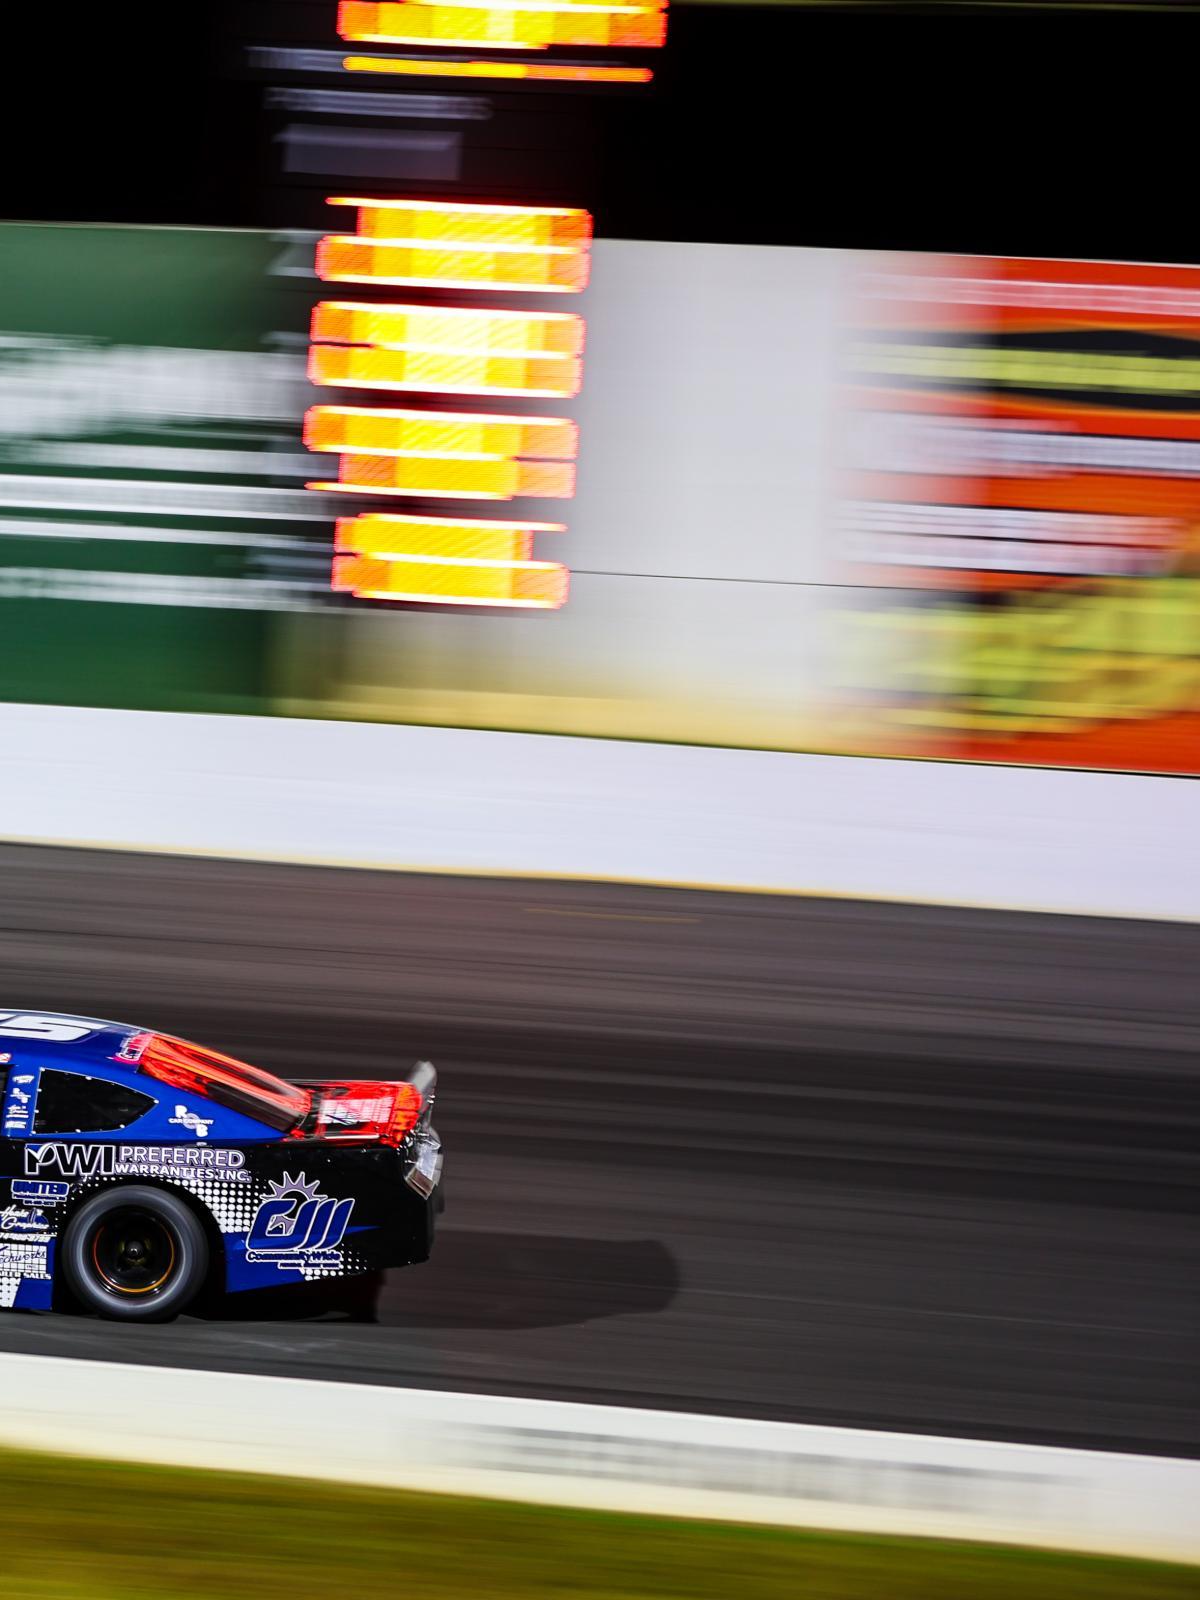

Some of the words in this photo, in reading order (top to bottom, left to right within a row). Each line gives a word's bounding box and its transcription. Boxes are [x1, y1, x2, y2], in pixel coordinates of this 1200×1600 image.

[24, 1142, 116, 1176] PWI
[119, 1146, 245, 1168] PREFERRED
[23, 1272, 52, 1280] SALES
